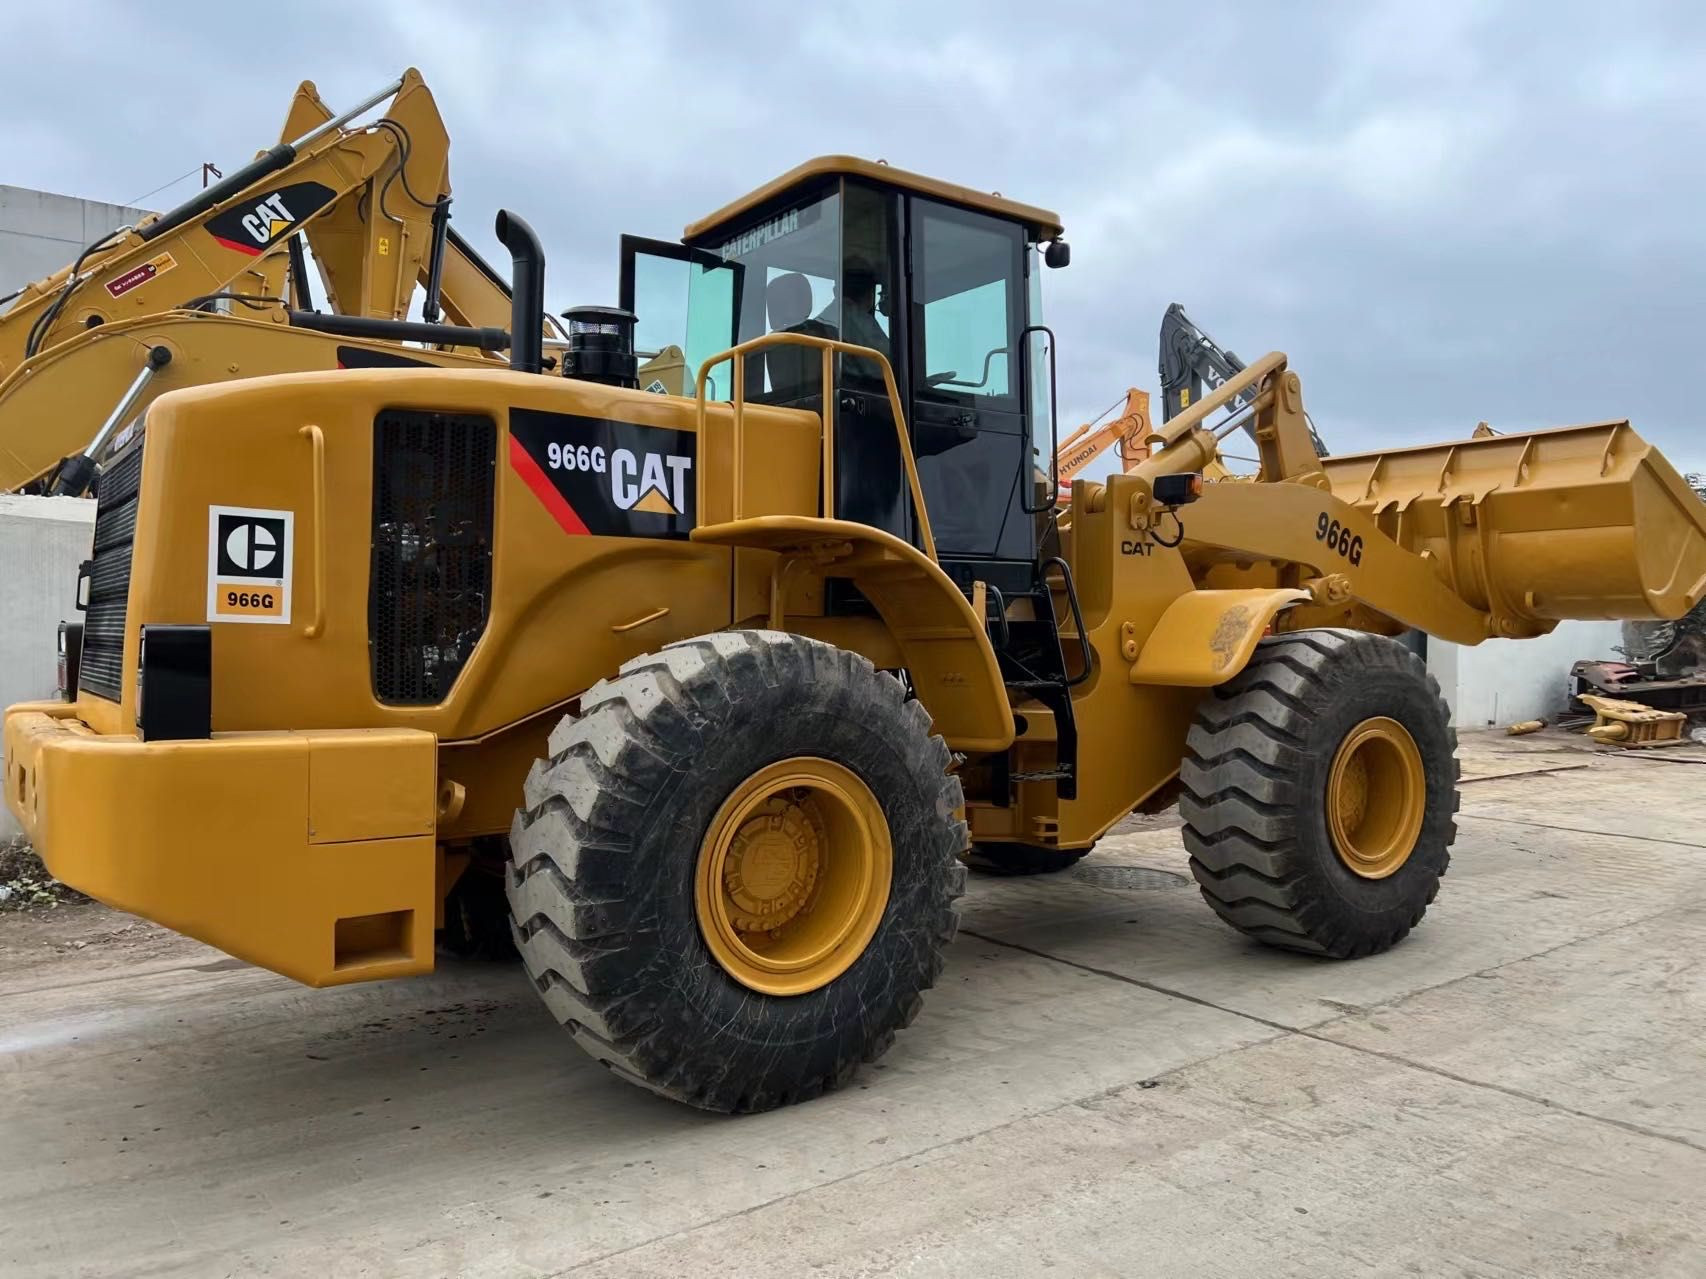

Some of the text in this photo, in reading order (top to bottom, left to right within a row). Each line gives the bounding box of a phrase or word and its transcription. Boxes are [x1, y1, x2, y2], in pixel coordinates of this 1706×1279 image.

[241, 192, 296, 244] CAT
[721, 207, 799, 263] CATERPILLAR
[547, 442, 692, 514] 966G CAT
[1059, 444, 1098, 475] HYUNDAI
[1121, 540, 1155, 556] CAT
[1315, 511, 1363, 567] 966G
[227, 591, 274, 609] 966G
